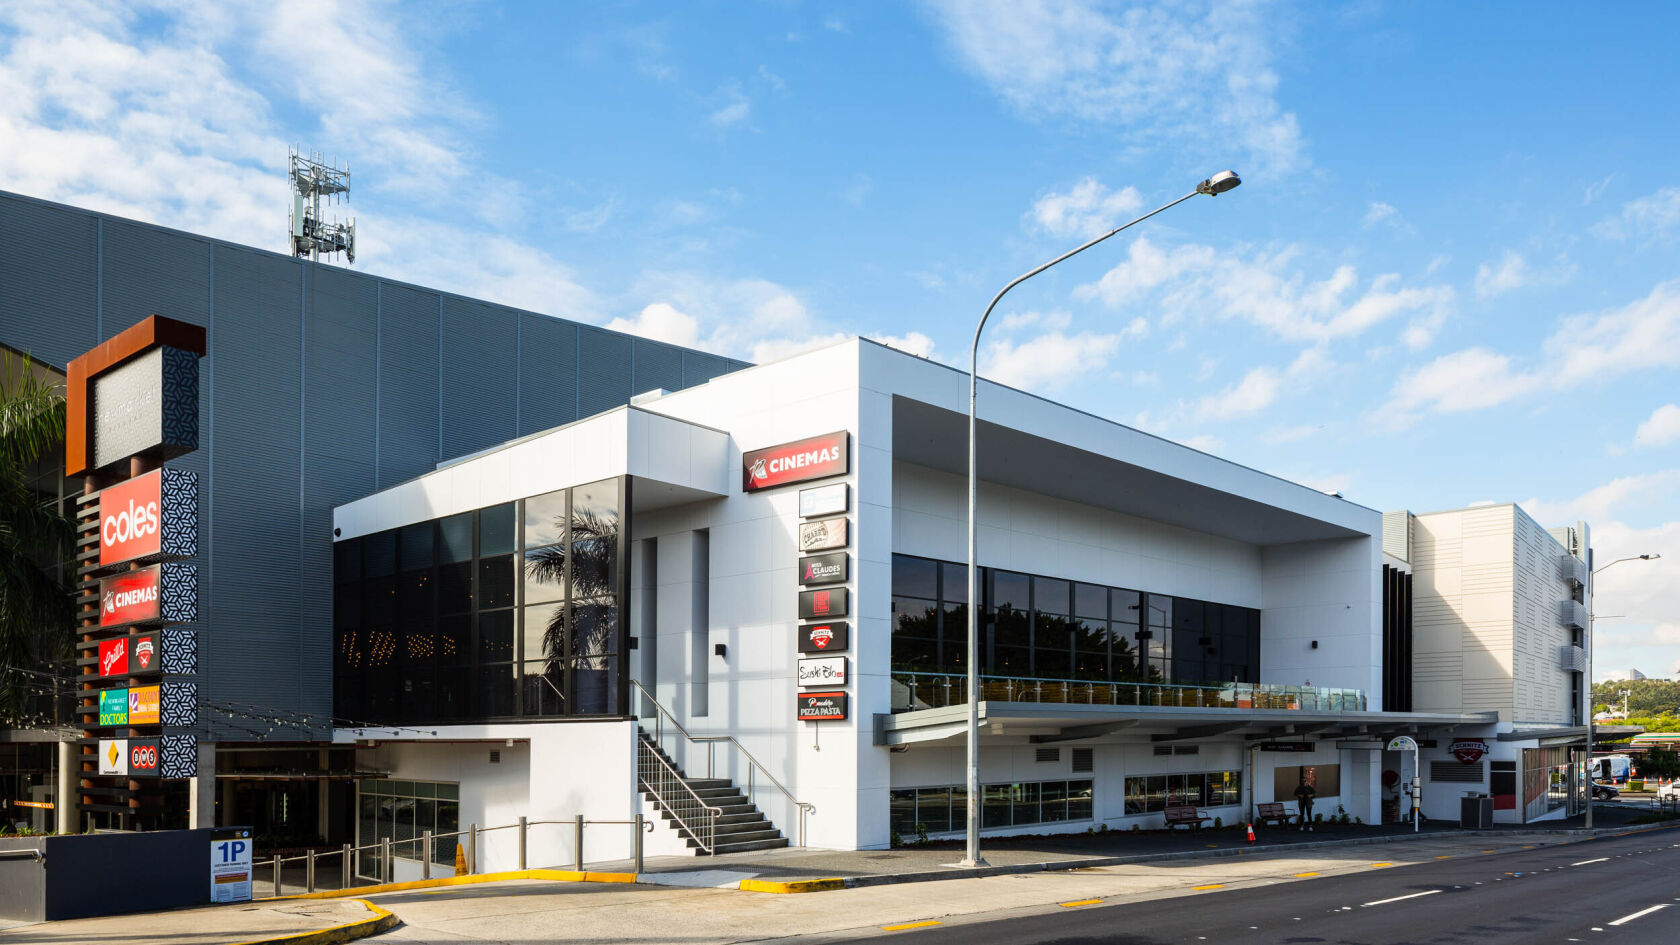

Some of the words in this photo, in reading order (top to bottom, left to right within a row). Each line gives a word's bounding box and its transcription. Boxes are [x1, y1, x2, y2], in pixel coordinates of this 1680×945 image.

[769, 446, 840, 473] CINEMAS
[103, 499, 158, 547] coles
[813, 564, 841, 574] CLAUDES
[115, 585, 158, 608] CINEMAS
[800, 665, 821, 680] Sushi
[100, 713, 127, 726] DOCTORS
[800, 708, 820, 716] PIZZA
[820, 707, 841, 715] PASTA
[218, 841, 246, 862] 1P
